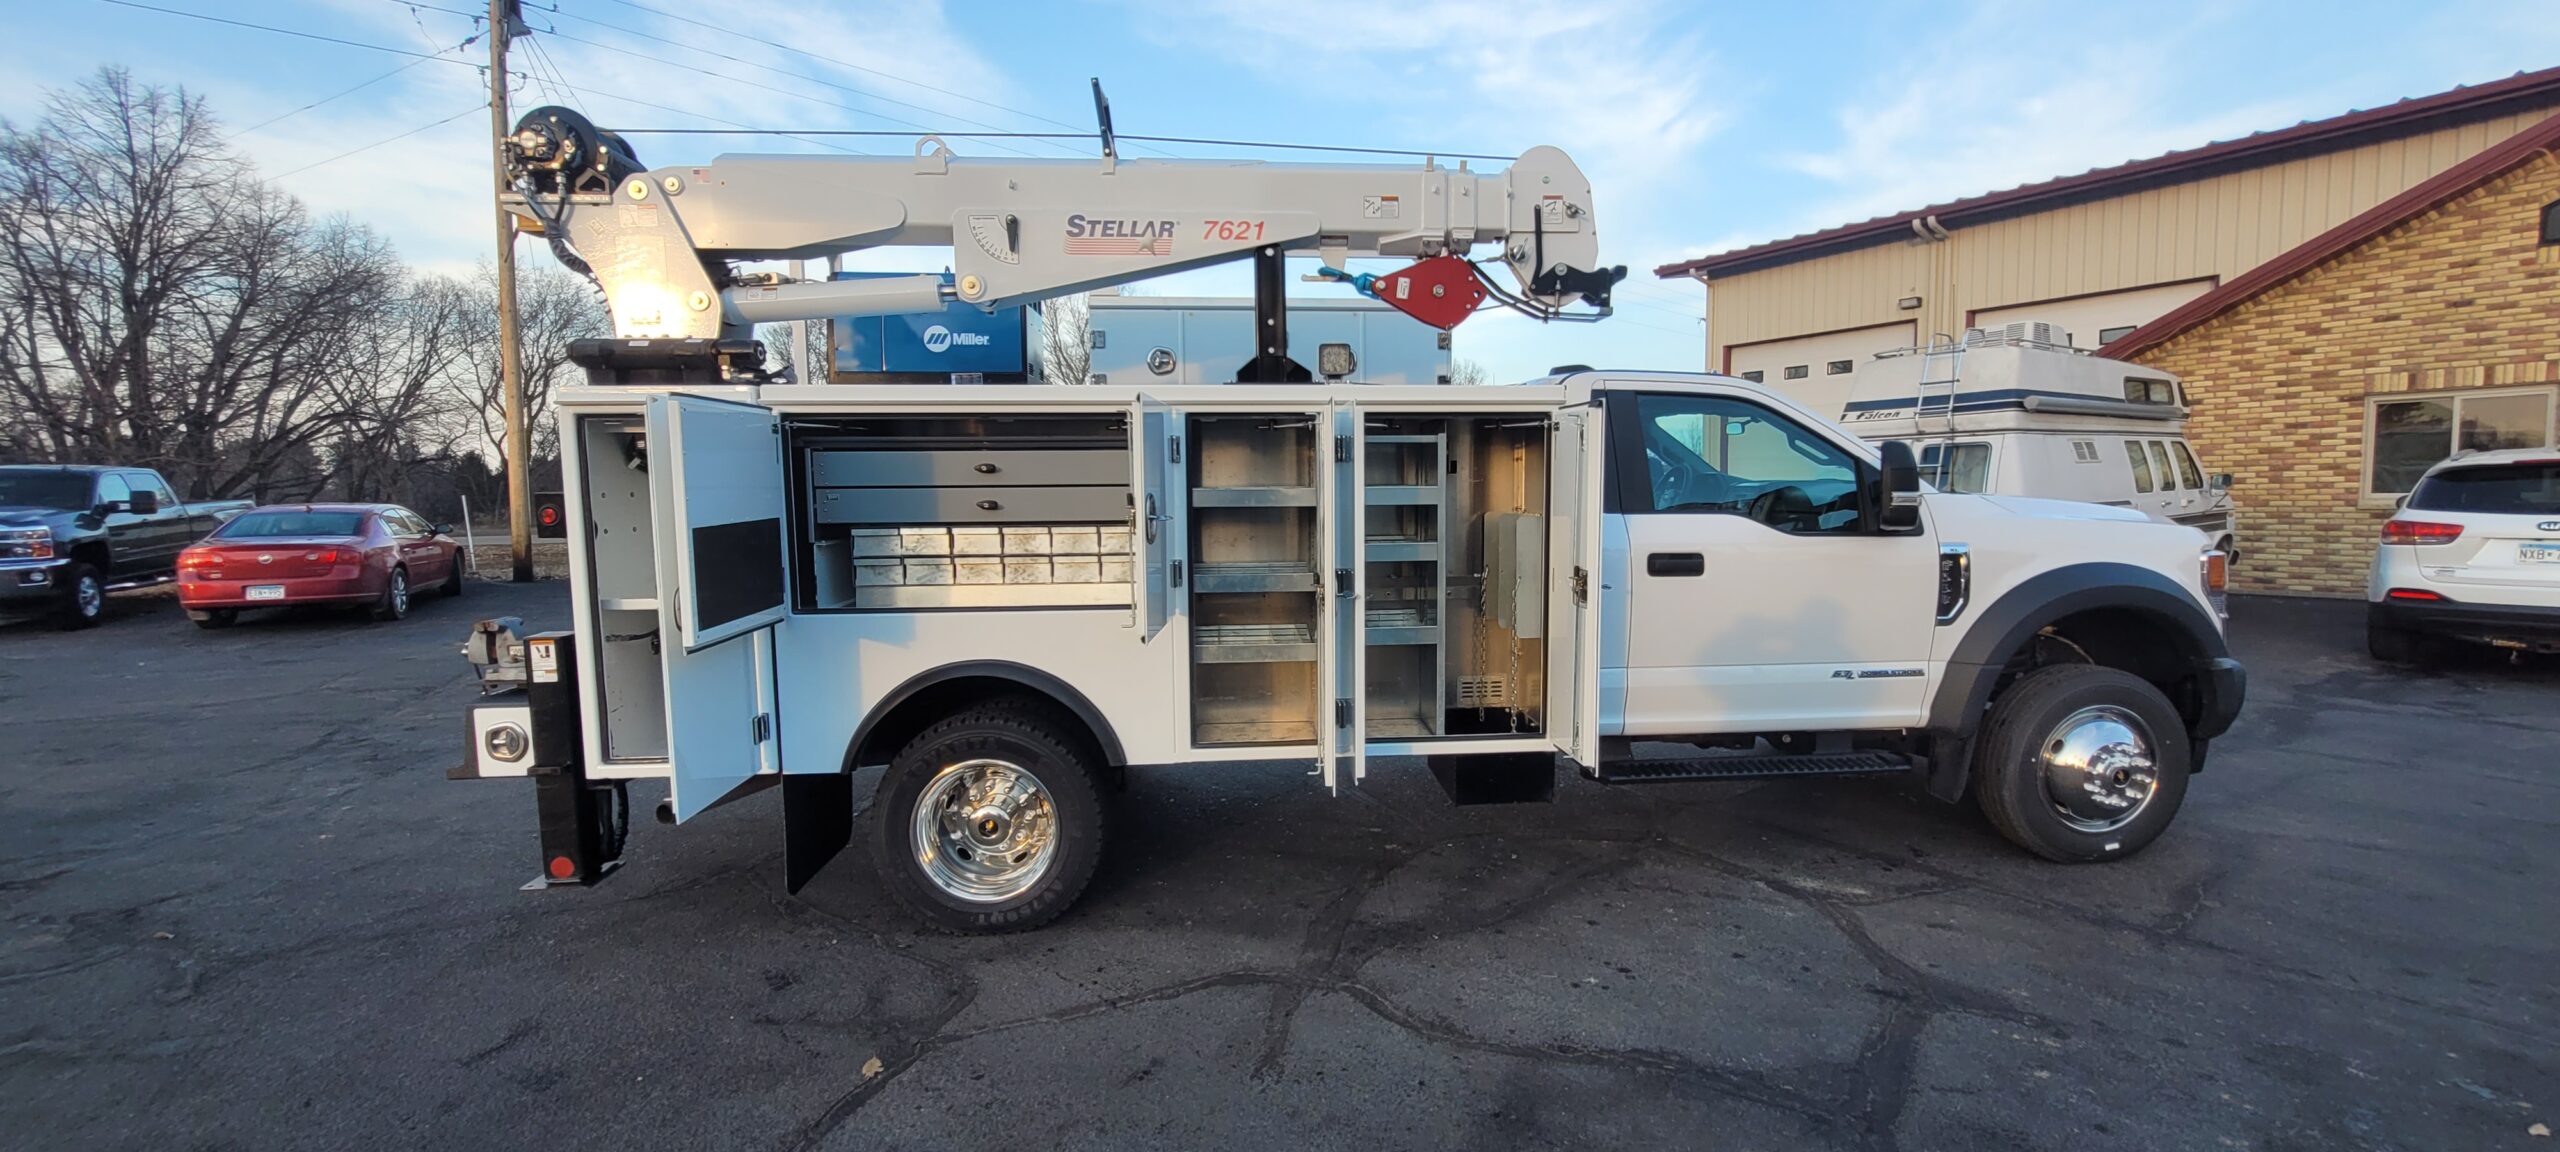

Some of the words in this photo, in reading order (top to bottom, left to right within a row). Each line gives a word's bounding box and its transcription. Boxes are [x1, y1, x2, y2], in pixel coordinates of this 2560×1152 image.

[1066, 214, 1175, 238] STELLAR
[1203, 220, 1265, 241] 7621
[952, 333, 990, 346] Miller
[1856, 411, 1901, 420] Falcon
